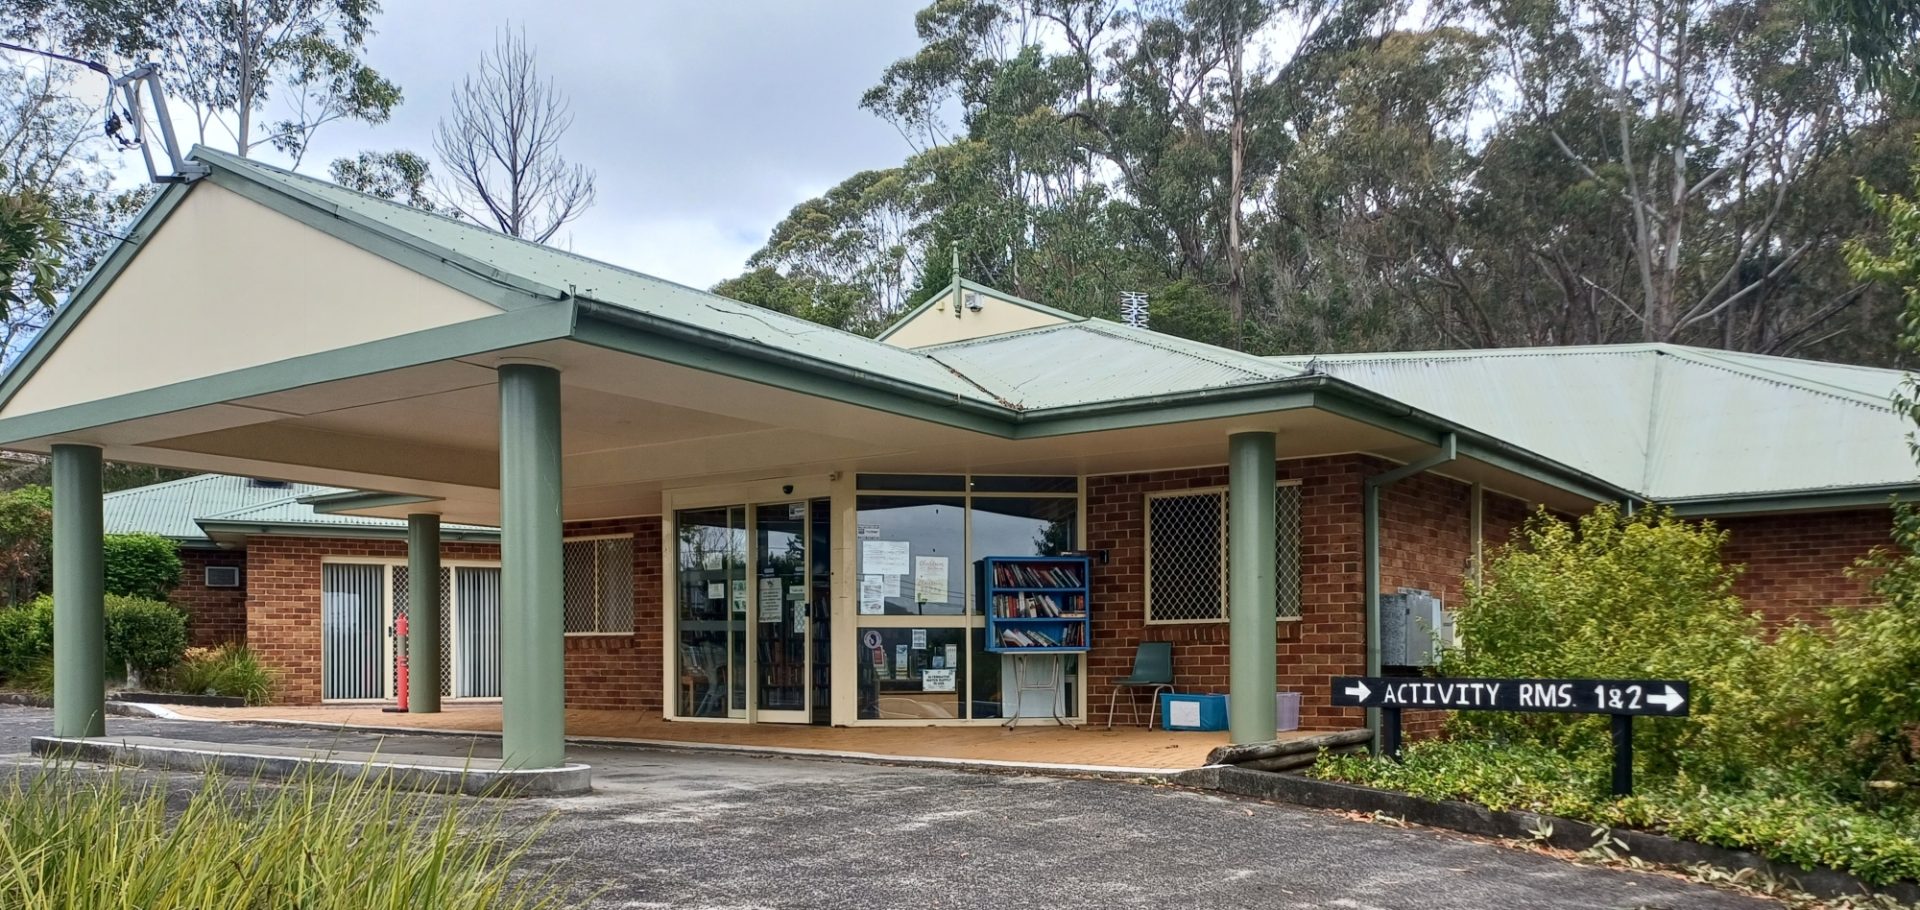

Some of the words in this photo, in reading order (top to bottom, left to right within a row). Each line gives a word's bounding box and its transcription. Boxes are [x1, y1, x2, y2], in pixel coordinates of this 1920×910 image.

[1384, 683, 1500, 706] ACTIVITY
[1519, 683, 1577, 708] RMS.
[1594, 684, 1642, 710] 1&2
